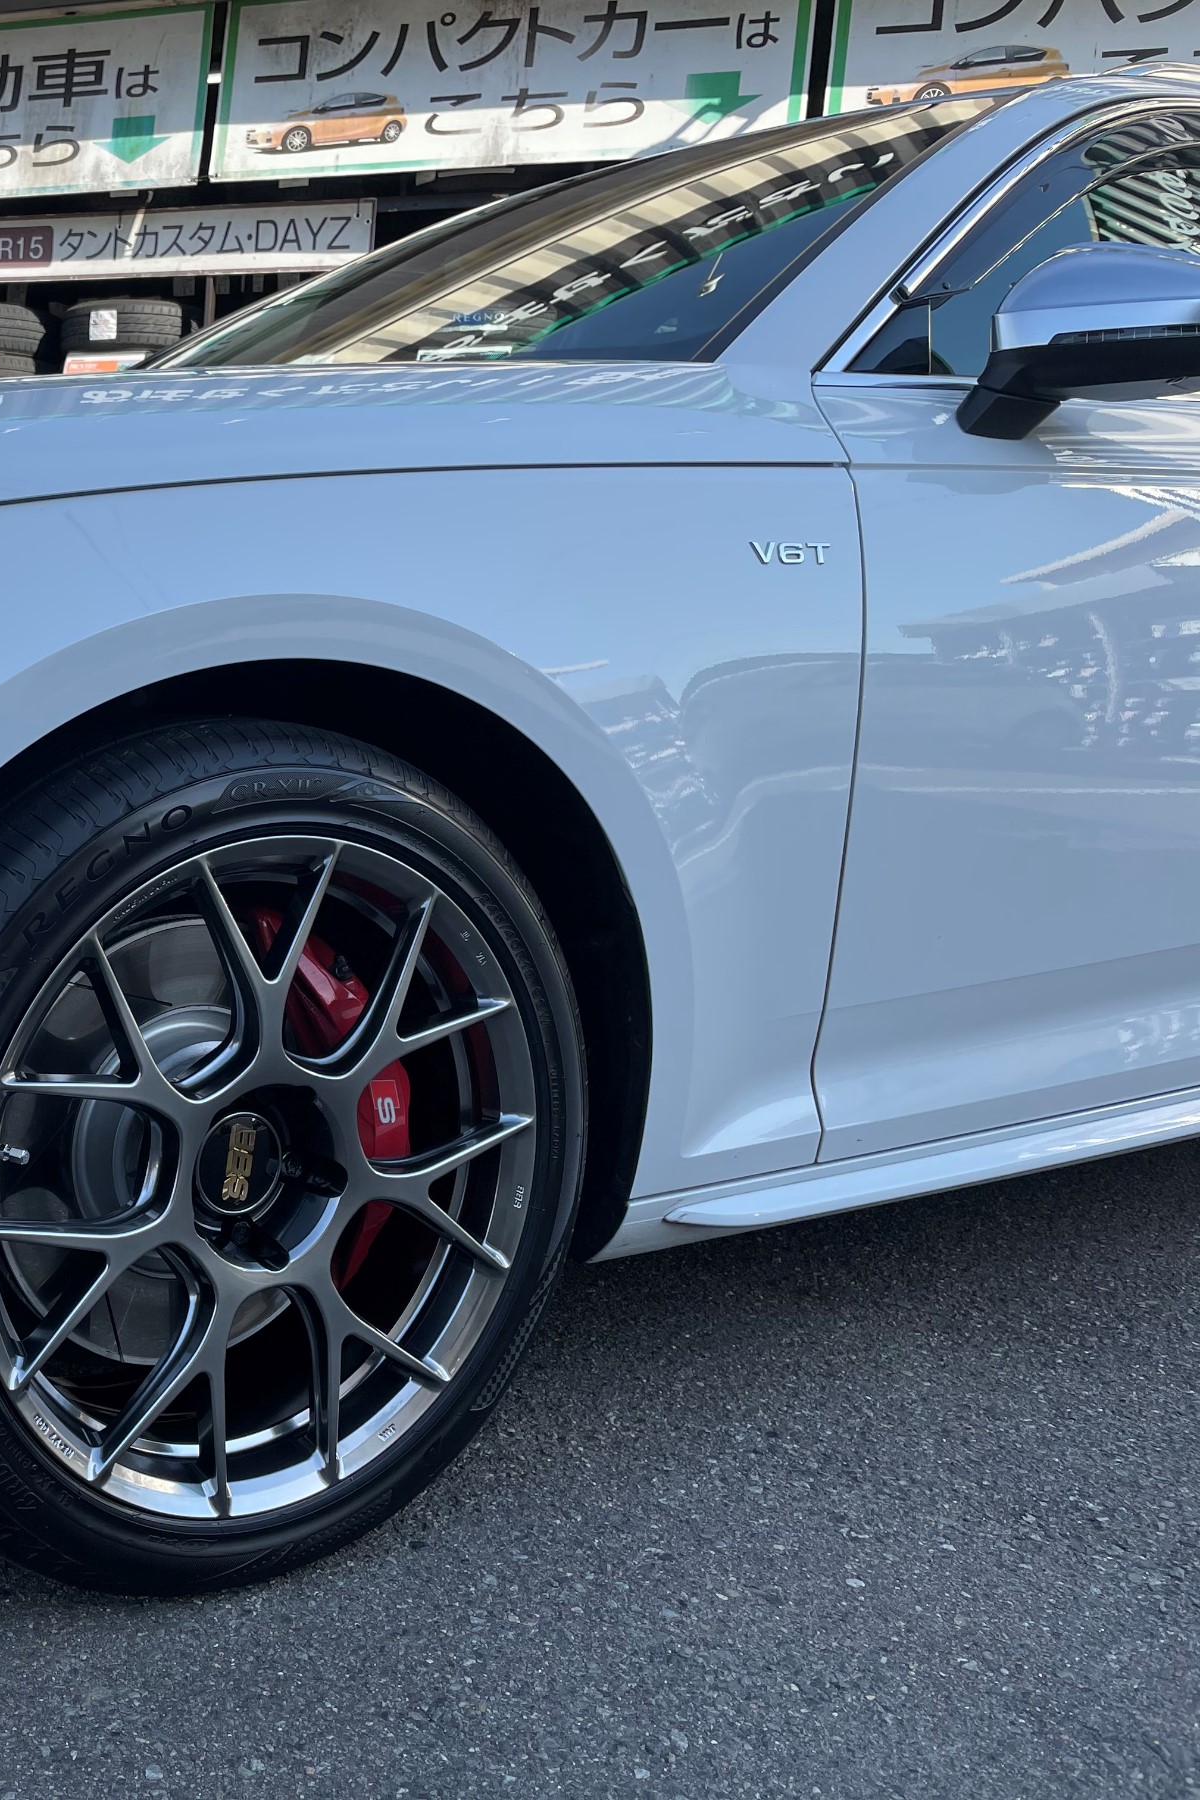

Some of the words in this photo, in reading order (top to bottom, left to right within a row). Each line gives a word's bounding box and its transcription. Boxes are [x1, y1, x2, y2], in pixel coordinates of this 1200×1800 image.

[254, 0, 781, 83] コンパクトカーは
[424, 81, 646, 136] こちら
[452, 312, 505, 322] REGNO
[748, 541, 831, 565] V6T
[18, 803, 194, 951] REGNO
[222, 1123, 257, 1202] BBS
